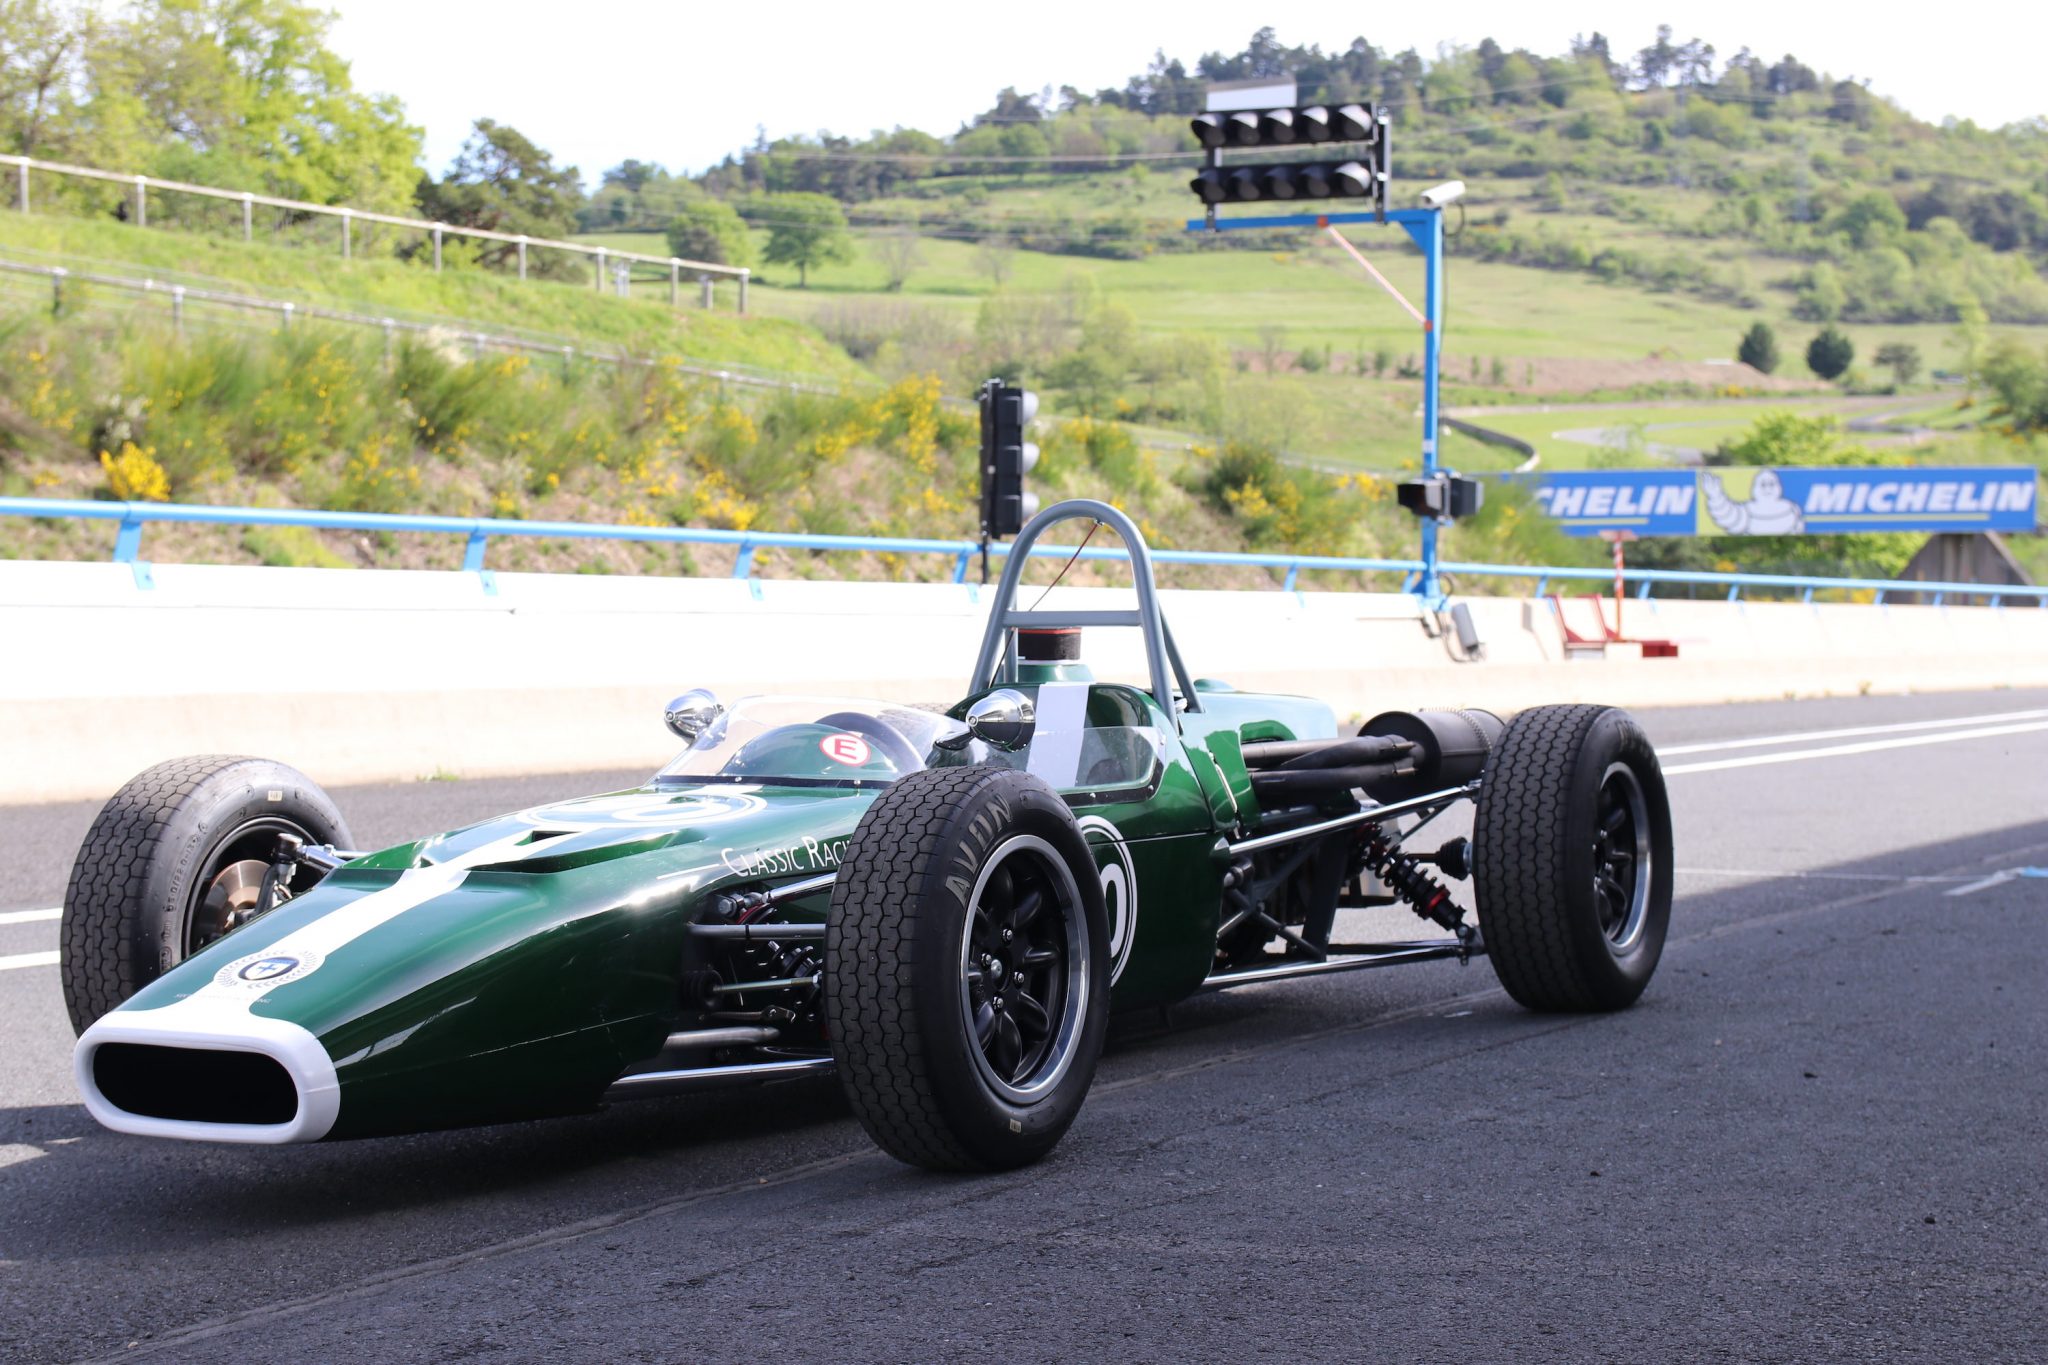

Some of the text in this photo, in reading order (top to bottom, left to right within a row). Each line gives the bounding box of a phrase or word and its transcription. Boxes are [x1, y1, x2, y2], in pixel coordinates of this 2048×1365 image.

[1532, 486, 1695, 517] CHELIN
[1804, 480, 2035, 514] MICHELIN
[834, 738, 857, 760] E
[945, 793, 1012, 911] AVON
